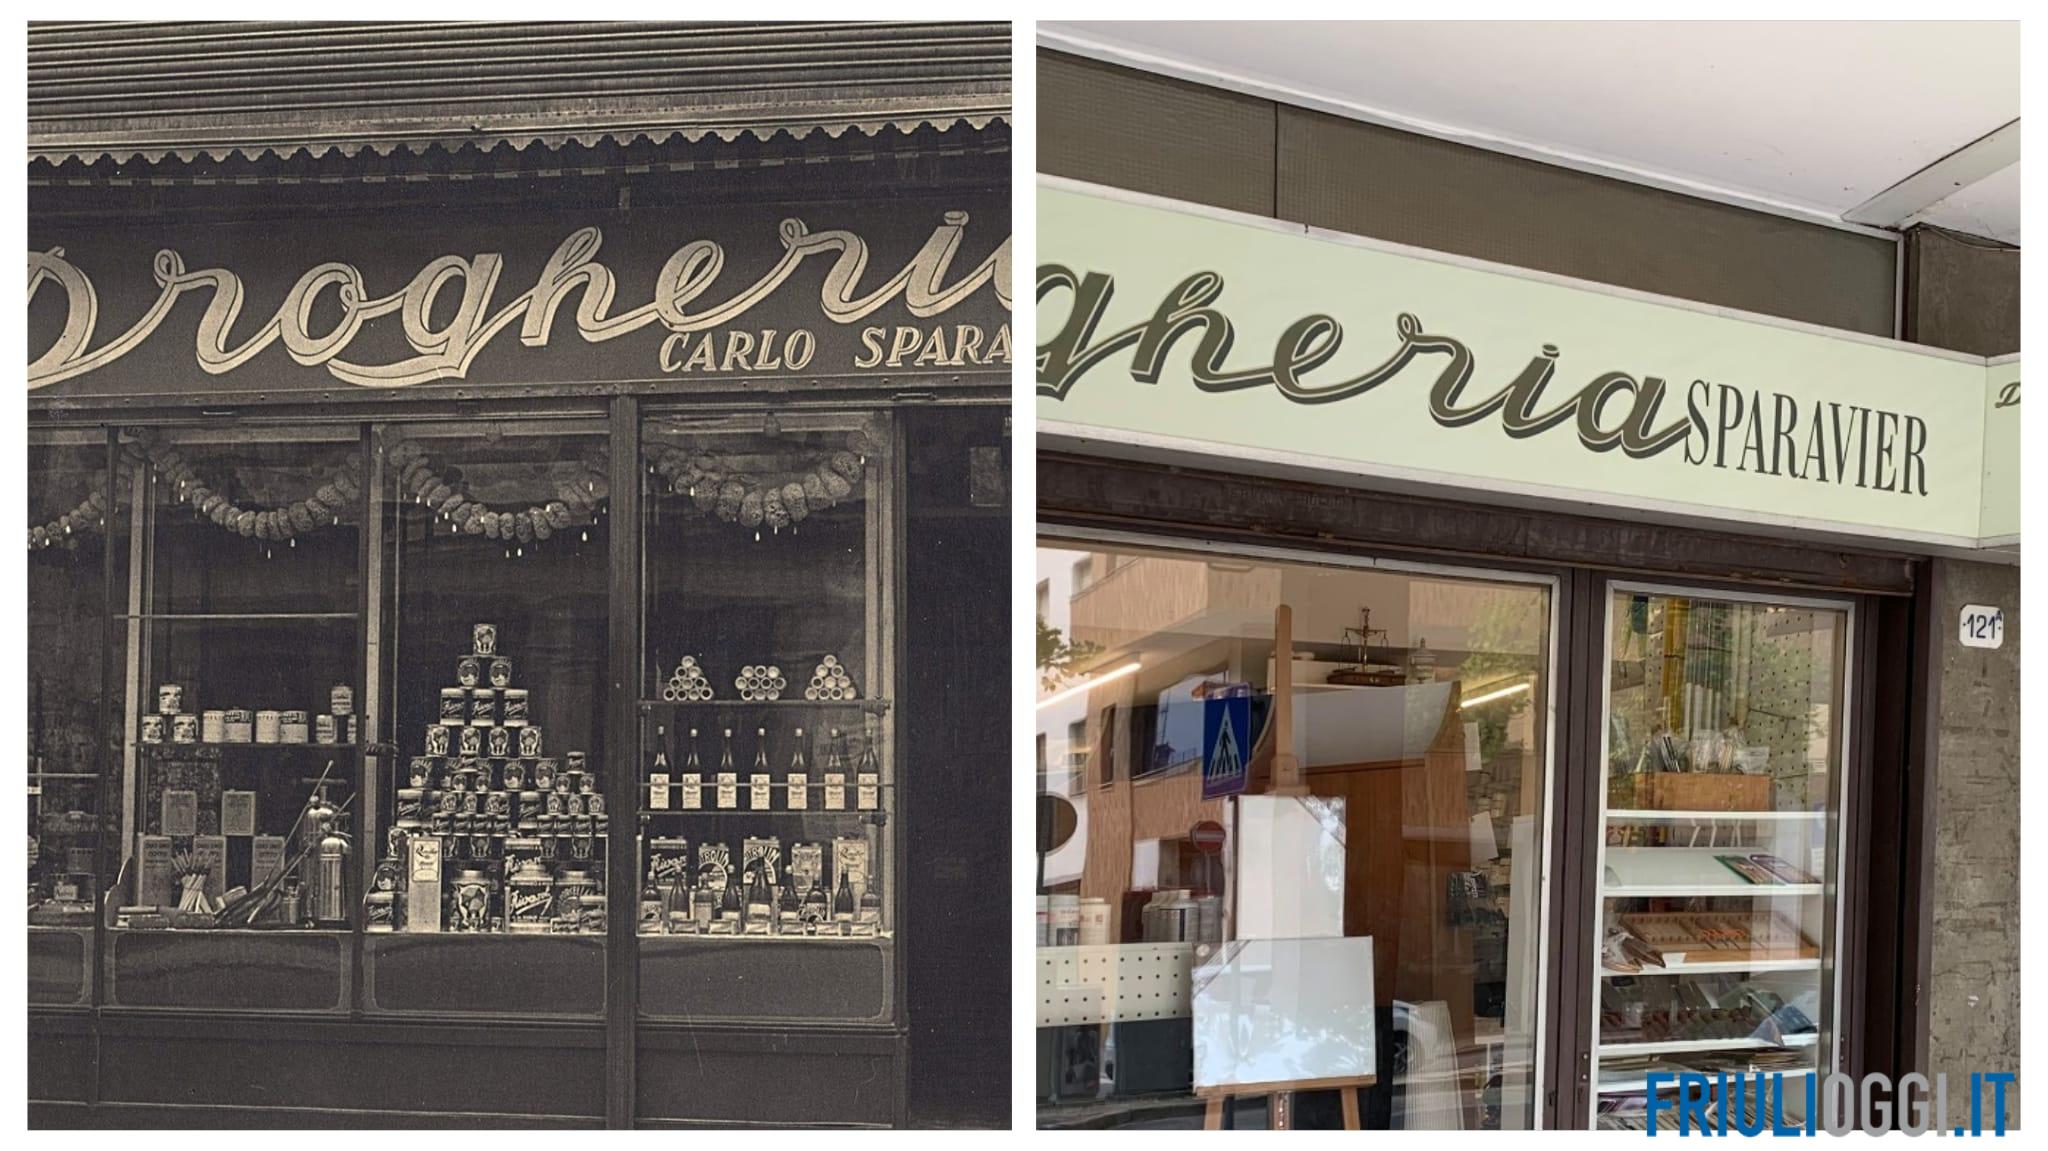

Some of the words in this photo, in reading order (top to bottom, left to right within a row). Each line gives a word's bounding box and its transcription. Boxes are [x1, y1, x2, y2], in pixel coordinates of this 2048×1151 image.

[659, 329, 816, 372] CARLO
[855, 323, 1012, 368] SPARA
[1684, 379, 1928, 496] SPARAVIER
